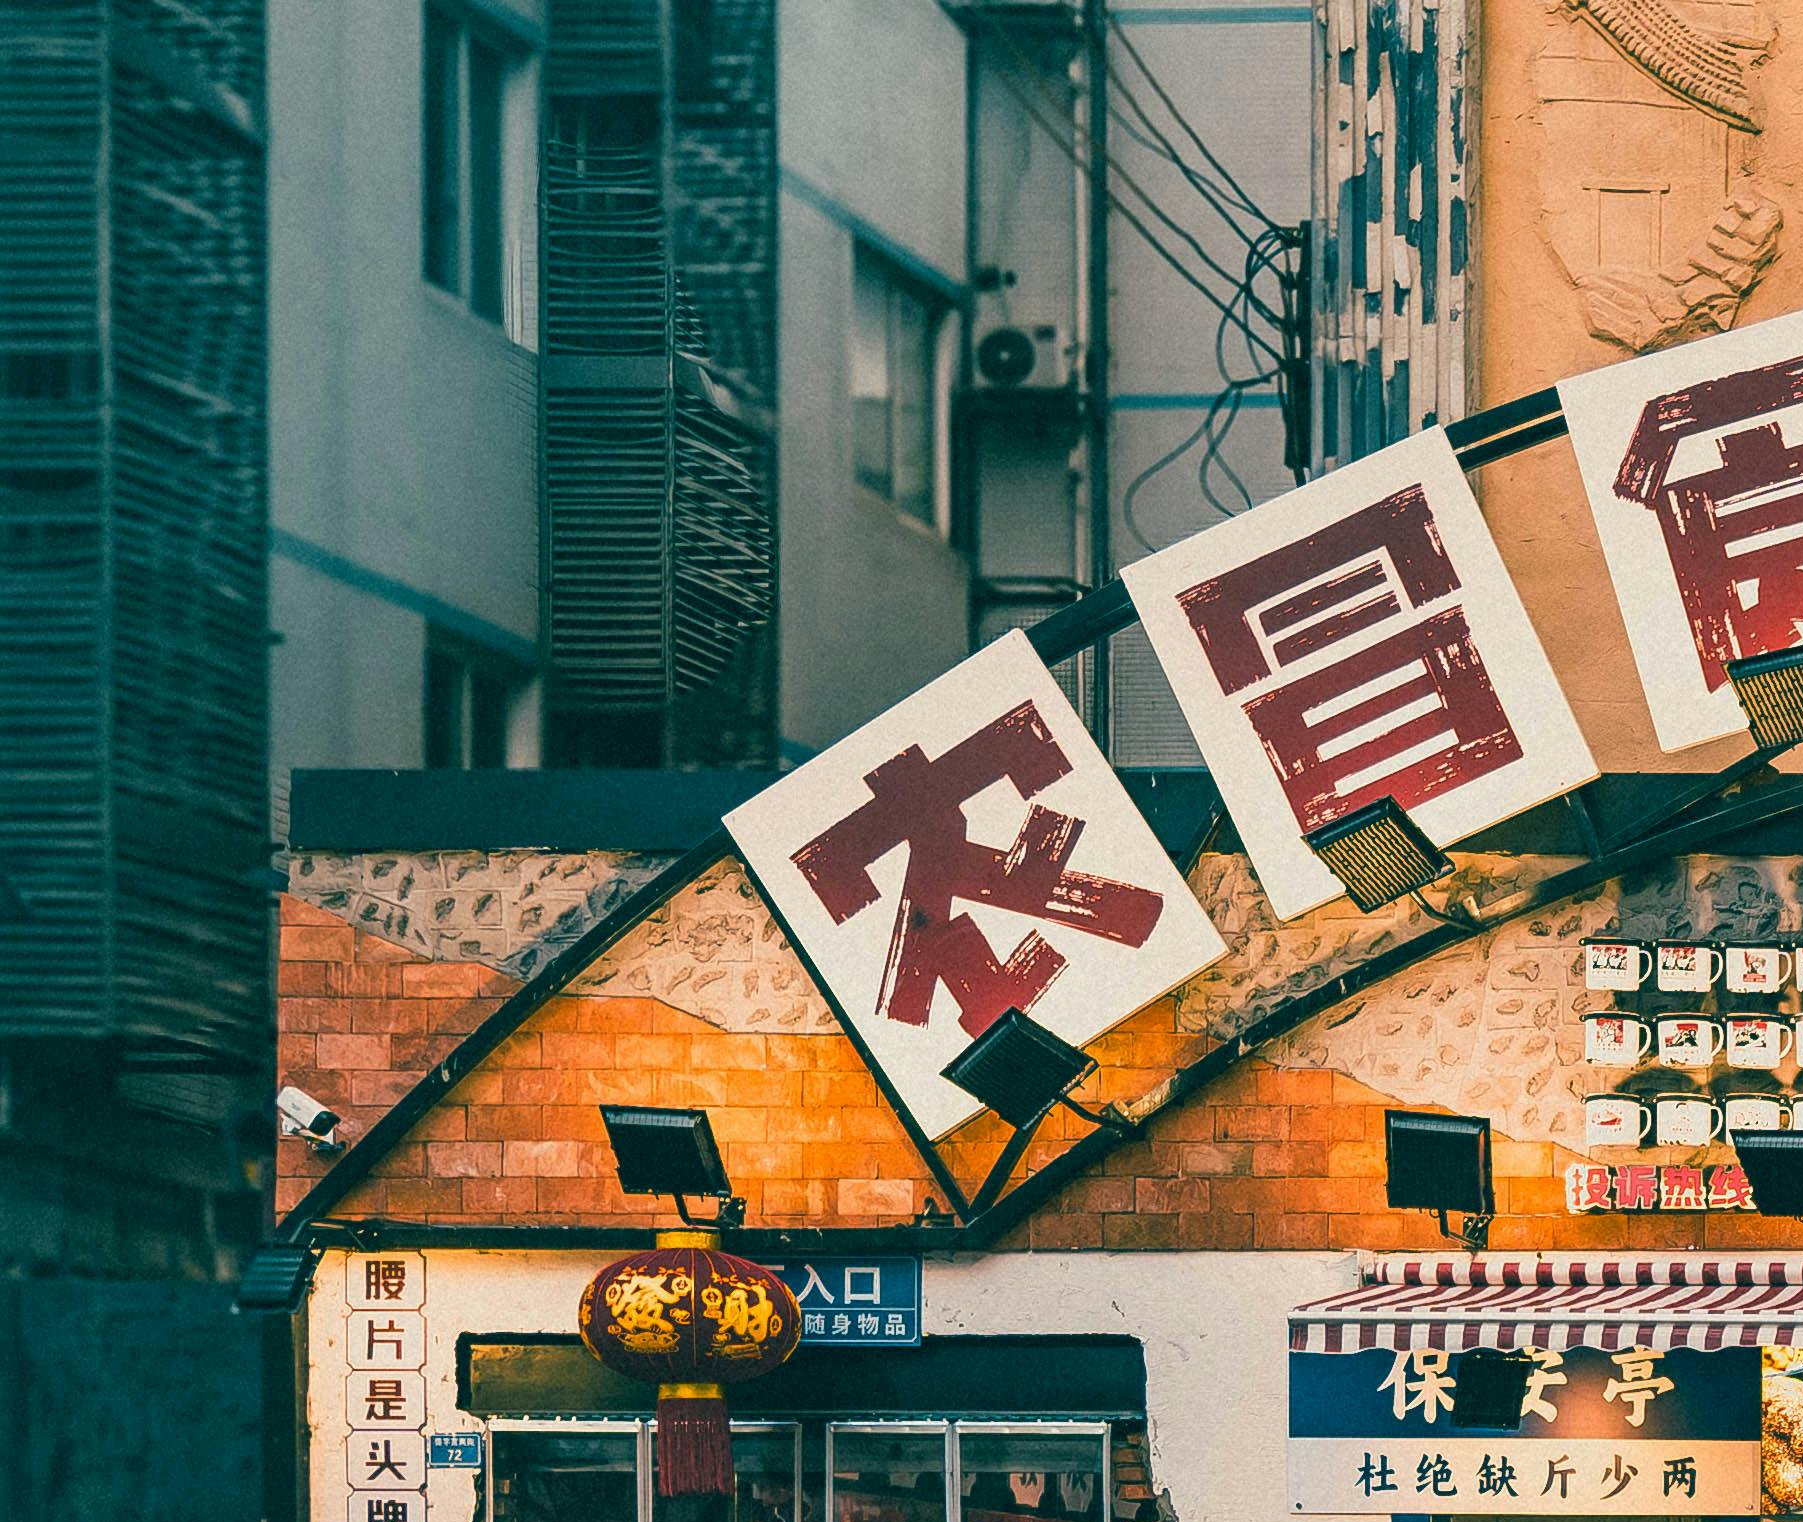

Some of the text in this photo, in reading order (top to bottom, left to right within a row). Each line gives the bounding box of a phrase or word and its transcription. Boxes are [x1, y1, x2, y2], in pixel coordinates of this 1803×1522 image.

[1566, 1163, 1755, 1212] 投诉热线
[768, 1264, 881, 1305] 入口
[804, 1313, 907, 1336] 随身物品
[448, 1449, 462, 1461] 72
[1355, 1451, 1699, 1499] 杜绝缺斤少两
